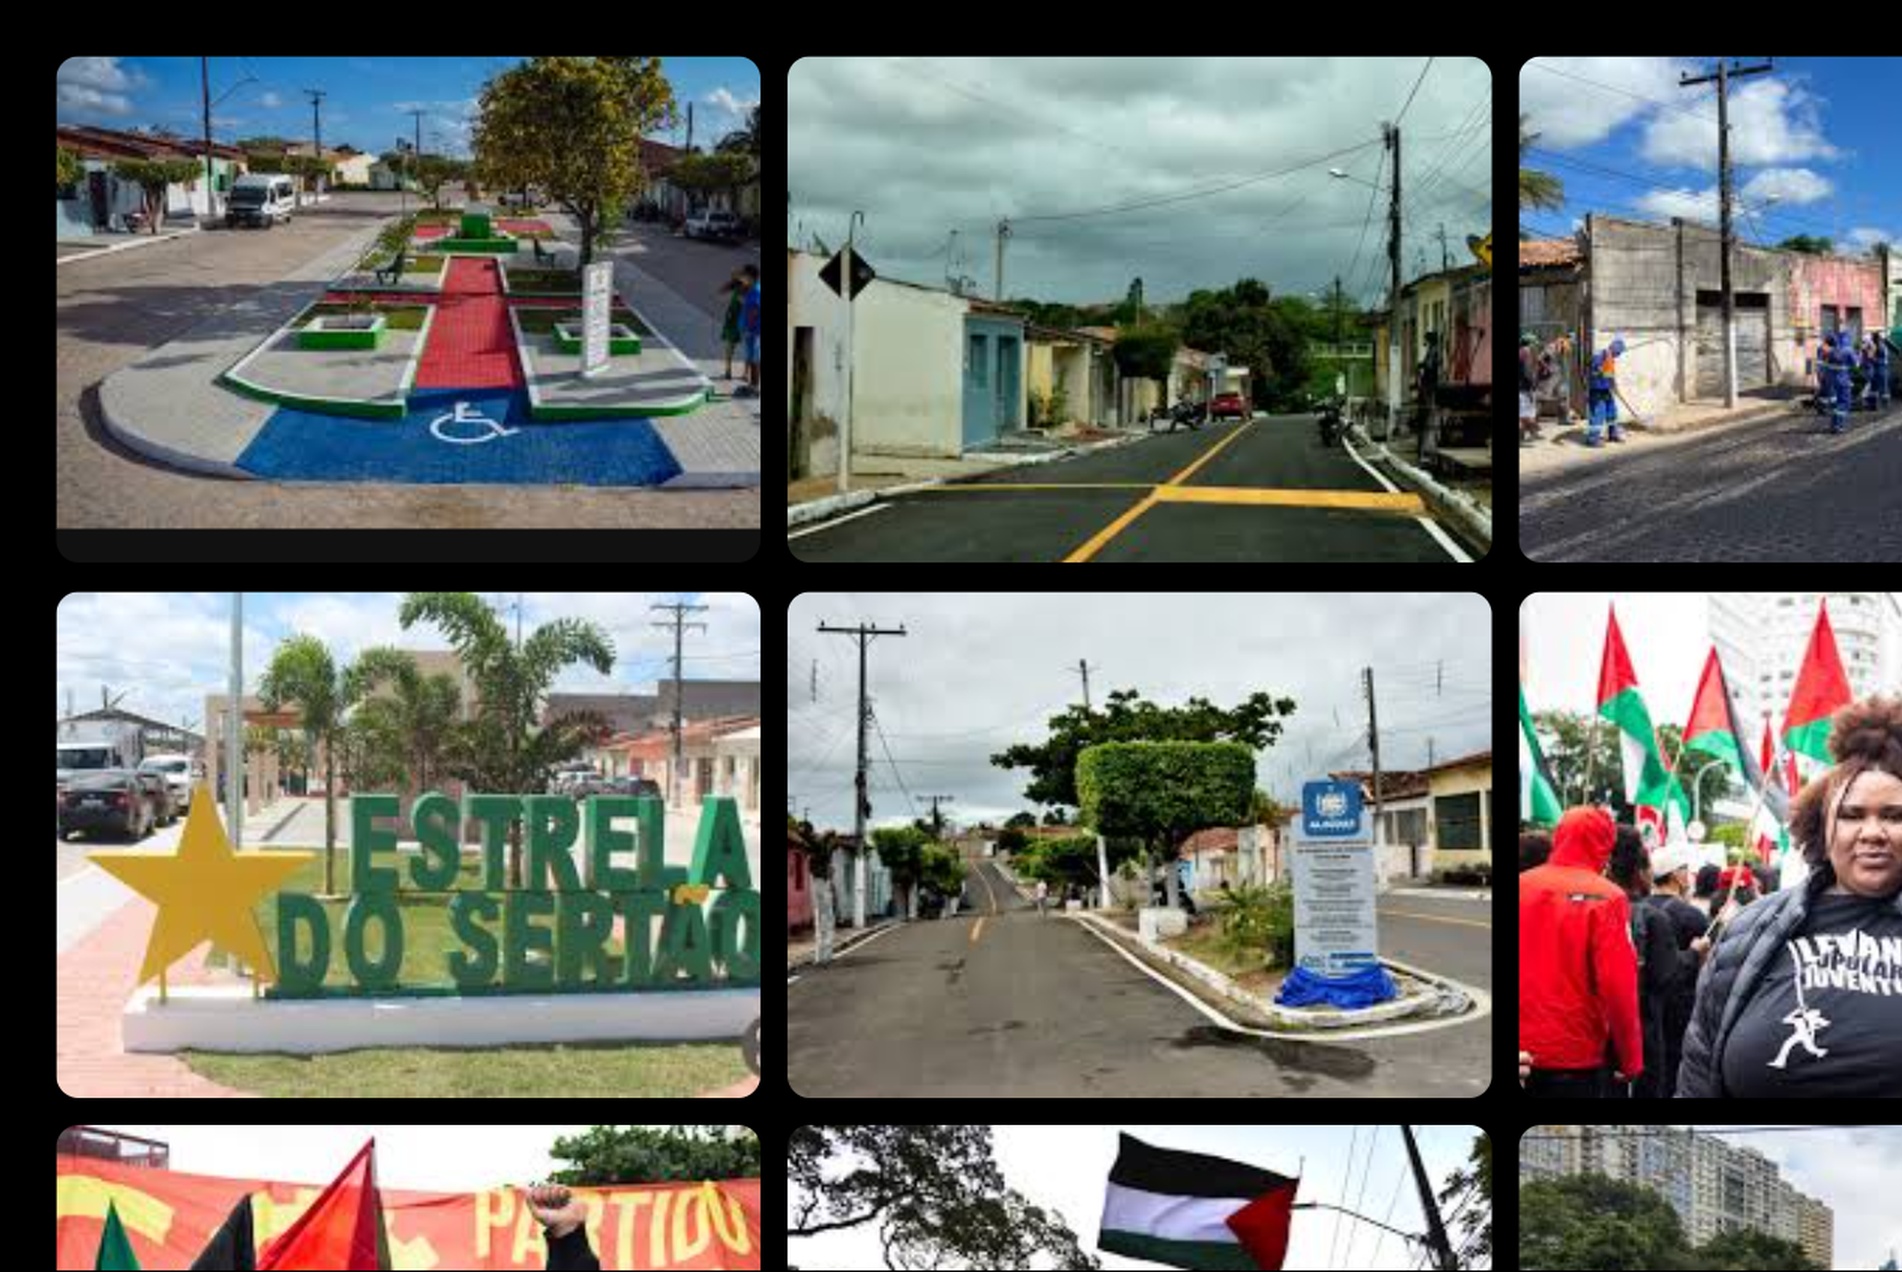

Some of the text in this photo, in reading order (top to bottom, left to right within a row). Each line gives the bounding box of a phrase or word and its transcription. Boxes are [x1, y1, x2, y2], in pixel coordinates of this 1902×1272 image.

[351, 792, 752, 892] ESTRELA
[277, 884, 760, 988] DO SERTÃO
